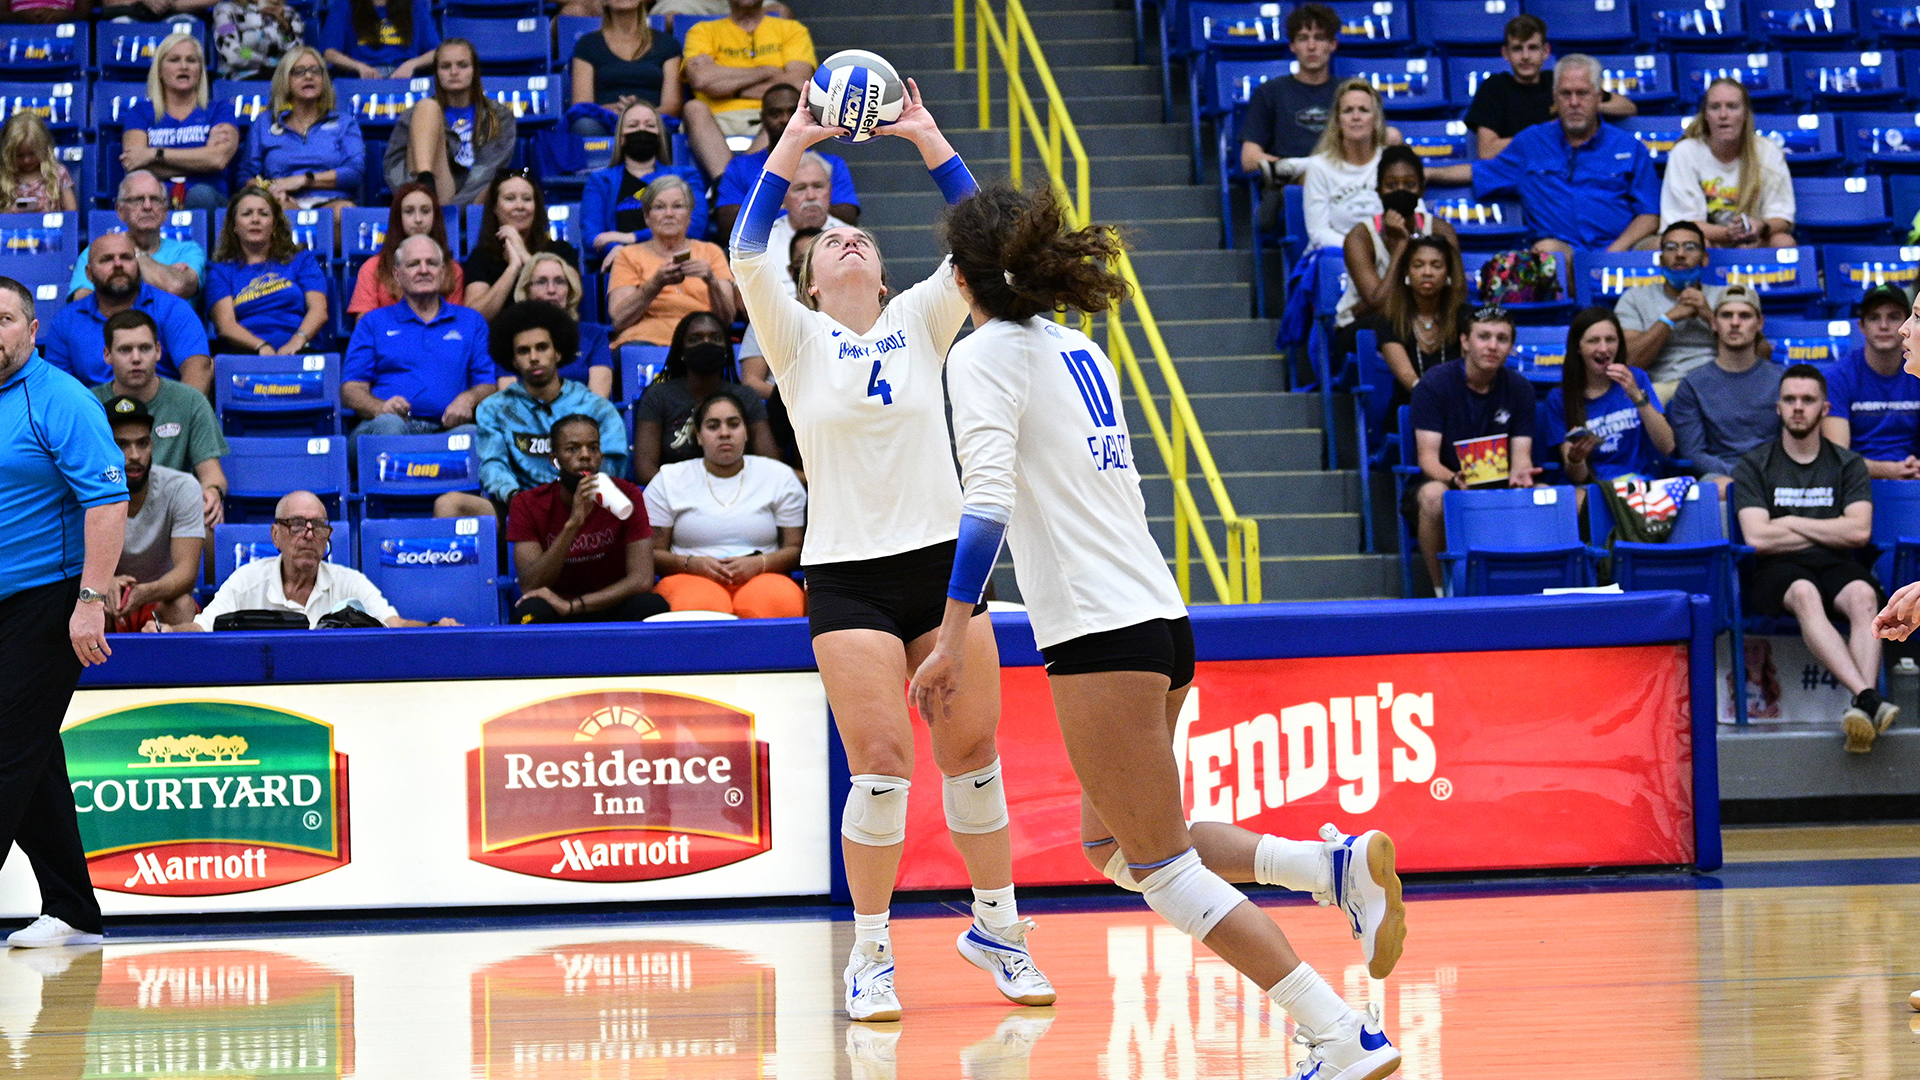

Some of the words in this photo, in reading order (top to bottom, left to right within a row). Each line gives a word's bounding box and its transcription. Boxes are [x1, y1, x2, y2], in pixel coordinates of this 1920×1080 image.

[844, 84, 863, 129] NCAA
[860, 84, 880, 134] molten
[253, 383, 301, 396] McManus
[867, 360, 893, 405] 4
[1060, 349, 1117, 427] 10
[406, 462, 440, 477] Long
[396, 549, 463, 565] sodexo
[504, 749, 732, 790] Residence
[71, 774, 322, 813] COURTYARD
[592, 792, 645, 816] Inn
[124, 847, 267, 888] Marriott
[550, 835, 691, 874] Marriott
